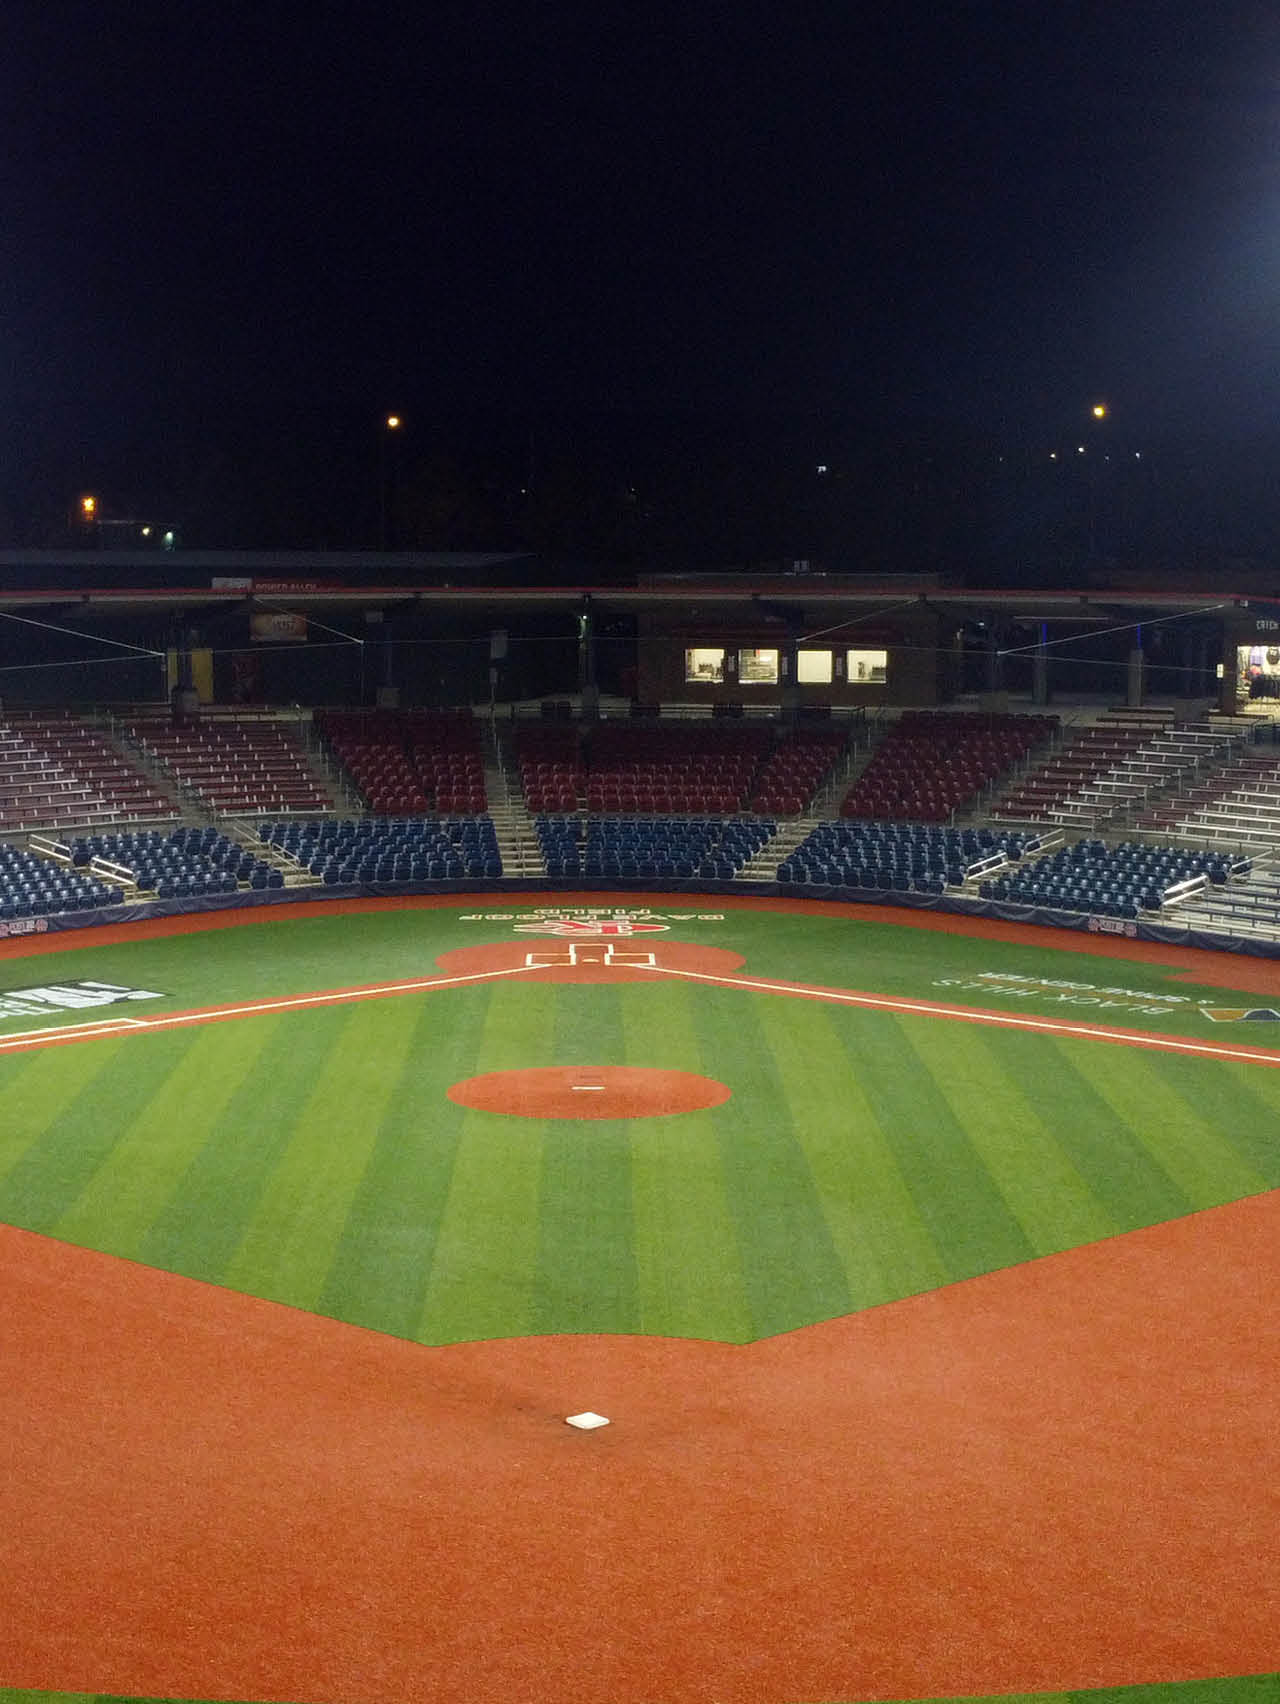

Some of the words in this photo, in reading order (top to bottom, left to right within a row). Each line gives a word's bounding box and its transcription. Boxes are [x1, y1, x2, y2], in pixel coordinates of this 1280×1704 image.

[930, 978, 1040, 997] HILLS
[977, 971, 1096, 990] CENTER
[1043, 993, 1175, 1015] BLACK
[1094, 987, 1192, 1003] SPINE
